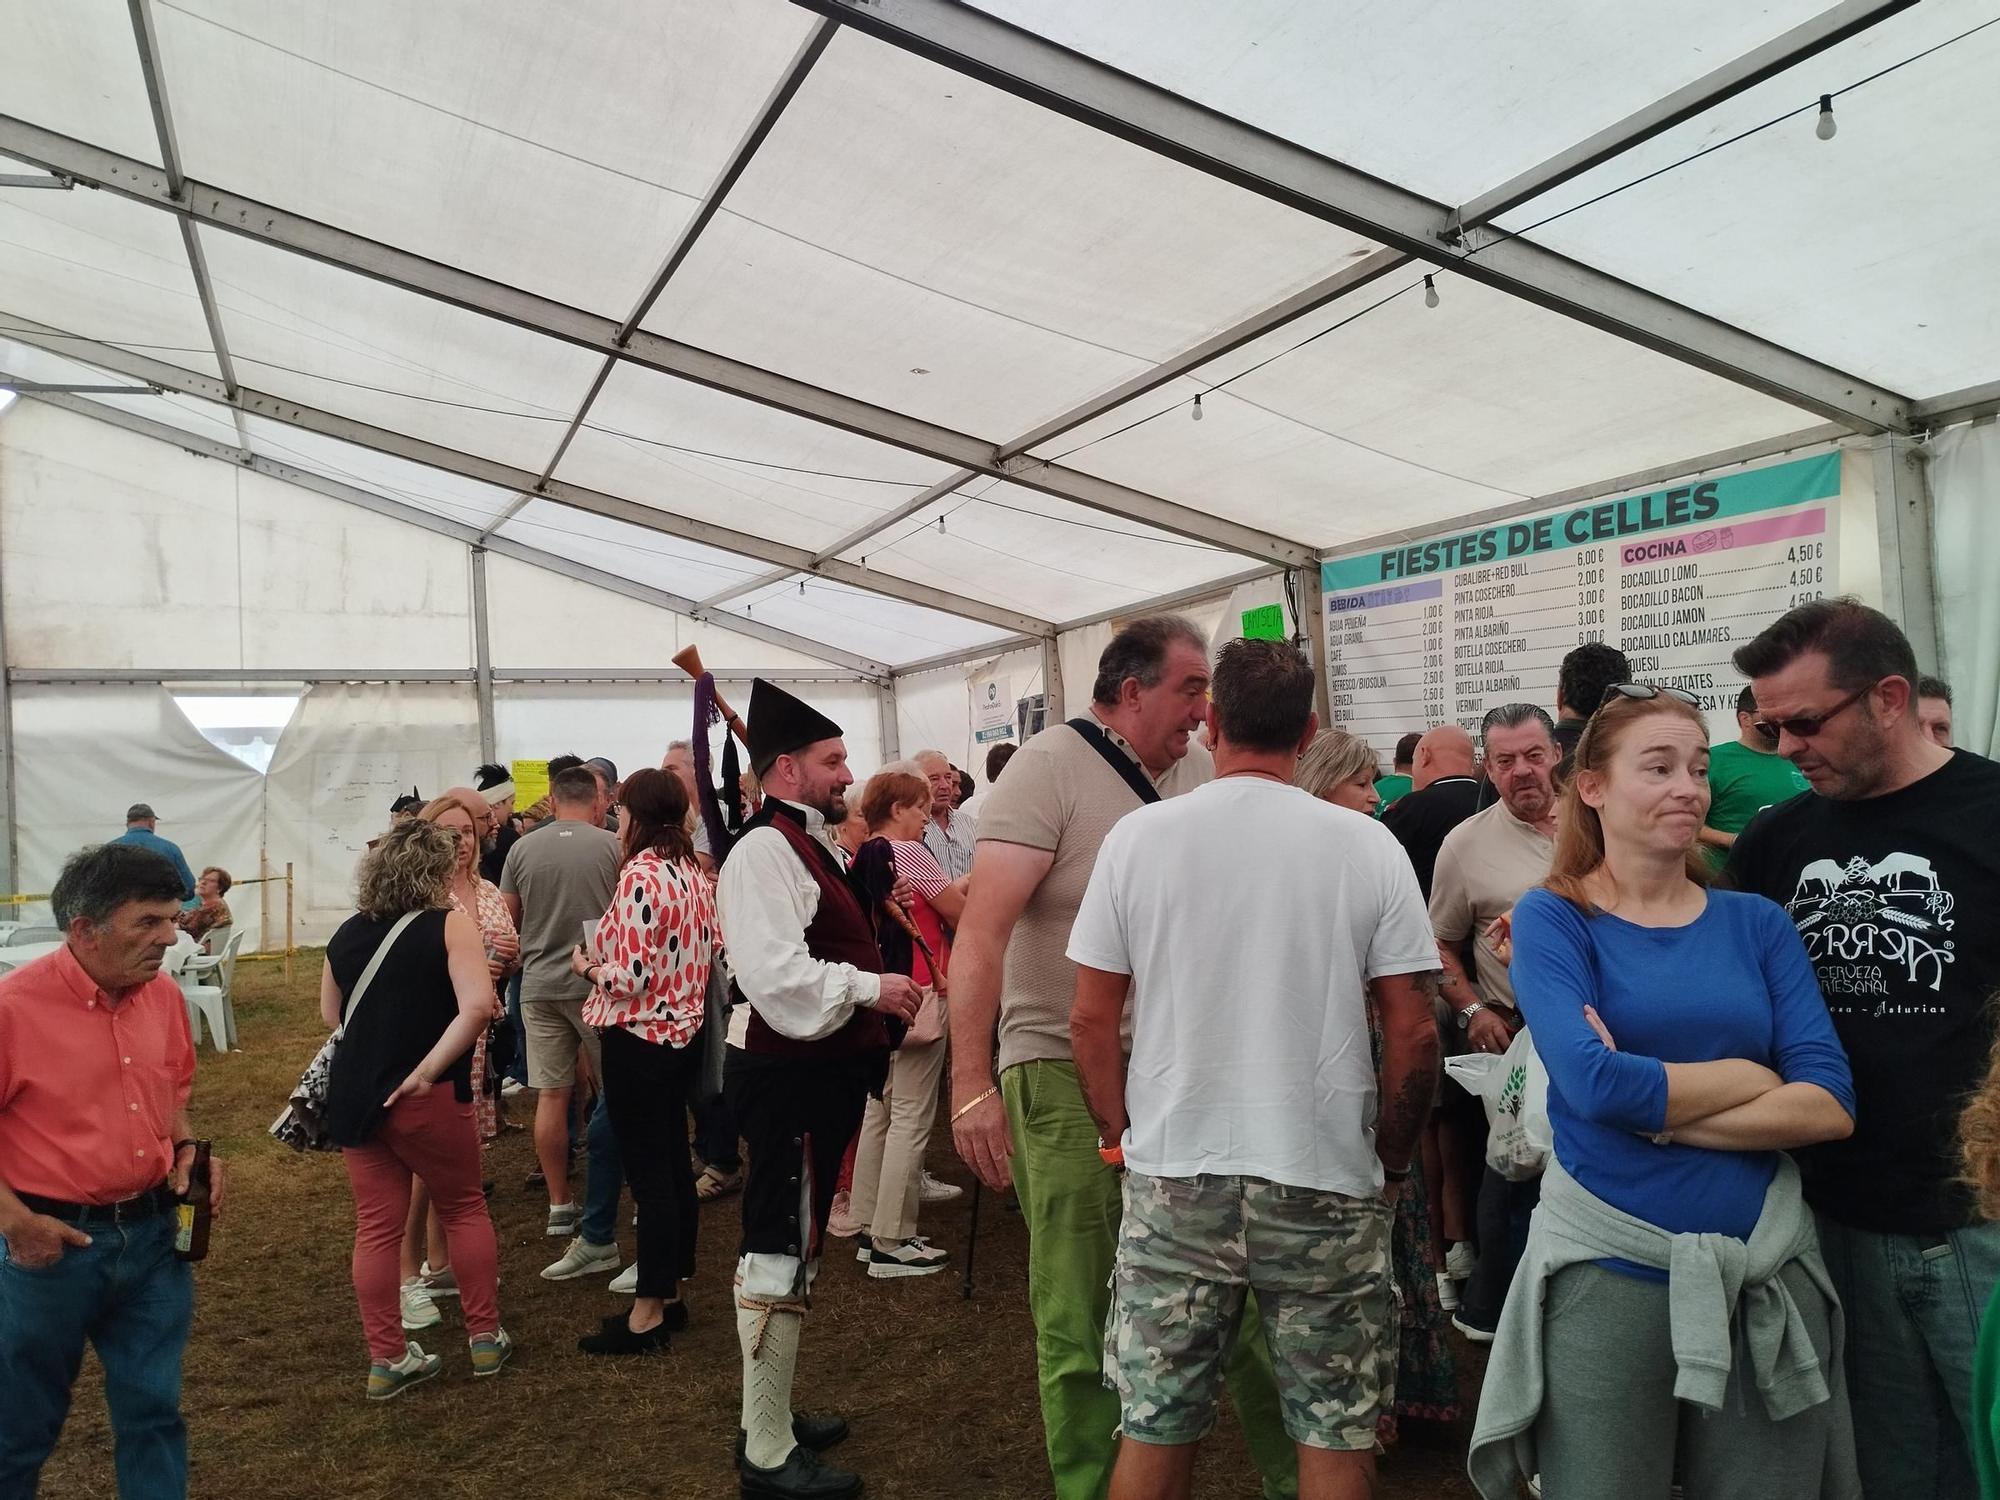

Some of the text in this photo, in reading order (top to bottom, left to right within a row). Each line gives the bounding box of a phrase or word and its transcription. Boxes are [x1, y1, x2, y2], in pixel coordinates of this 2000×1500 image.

[1381, 482, 1720, 580] FIESTES DE CELLES
[1624, 540, 1687, 563] COCINA
[1511, 562, 1529, 577] BULL
[1577, 550, 1596, 567] 6,00
[1621, 542, 1823, 589] BOCADILLO LOMO 4,50 €
[1454, 590, 1473, 605] PINTA
[1474, 583, 1516, 602] COSECHERO
[1578, 570, 1597, 587] 2,00
[1621, 566, 1823, 610] BOCADILLO BACON 4,50 €
[1330, 596, 1366, 612] BEBIDA
[1454, 609, 1473, 624] PINTA
[1474, 605, 1494, 620] RIOJA
[1578, 590, 1597, 606] 3,00
[1621, 611, 1669, 631] BOCADILLO
[1671, 607, 1705, 625] JAMON
[1789, 592, 1812, 608] 450
[1329, 619, 1343, 631] AGUA
[1424, 605, 1437, 619] 1,00
[1454, 626, 1473, 641] PINTA
[1474, 620, 1509, 638] ALBARIÑO
[1578, 610, 1597, 627] 3,00
[1422, 622, 1437, 636] 2,00
[1424, 639, 1437, 652] 1,00
[1454, 643, 1483, 659] BOTELLA
[1485, 638, 1527, 656] COSECHERO
[1621, 626, 1730, 652] BOCADILLO CALAMARES
[1423, 655, 1437, 669] 2,00
[1454, 659, 1504, 677] BOTELLA RIOJA
[1423, 671, 1438, 685] 2,50
[1455, 675, 1520, 695] BOTELLA ALBARIÑO
[1671, 673, 1714, 690] PATATES
[1333, 694, 1353, 706] CERVEZA
[1423, 688, 1438, 701] 2,50
[1455, 698, 1483, 713] VERMUT
[1334, 710, 1342, 721] RED
[1342, 709, 1354, 720] BULL
[1424, 704, 1439, 718] 3,00
[1817, 963, 1882, 982] CERVEZA
[1819, 977, 1890, 996] RTESANAL
[1874, 1001, 1946, 1018] Asturias
